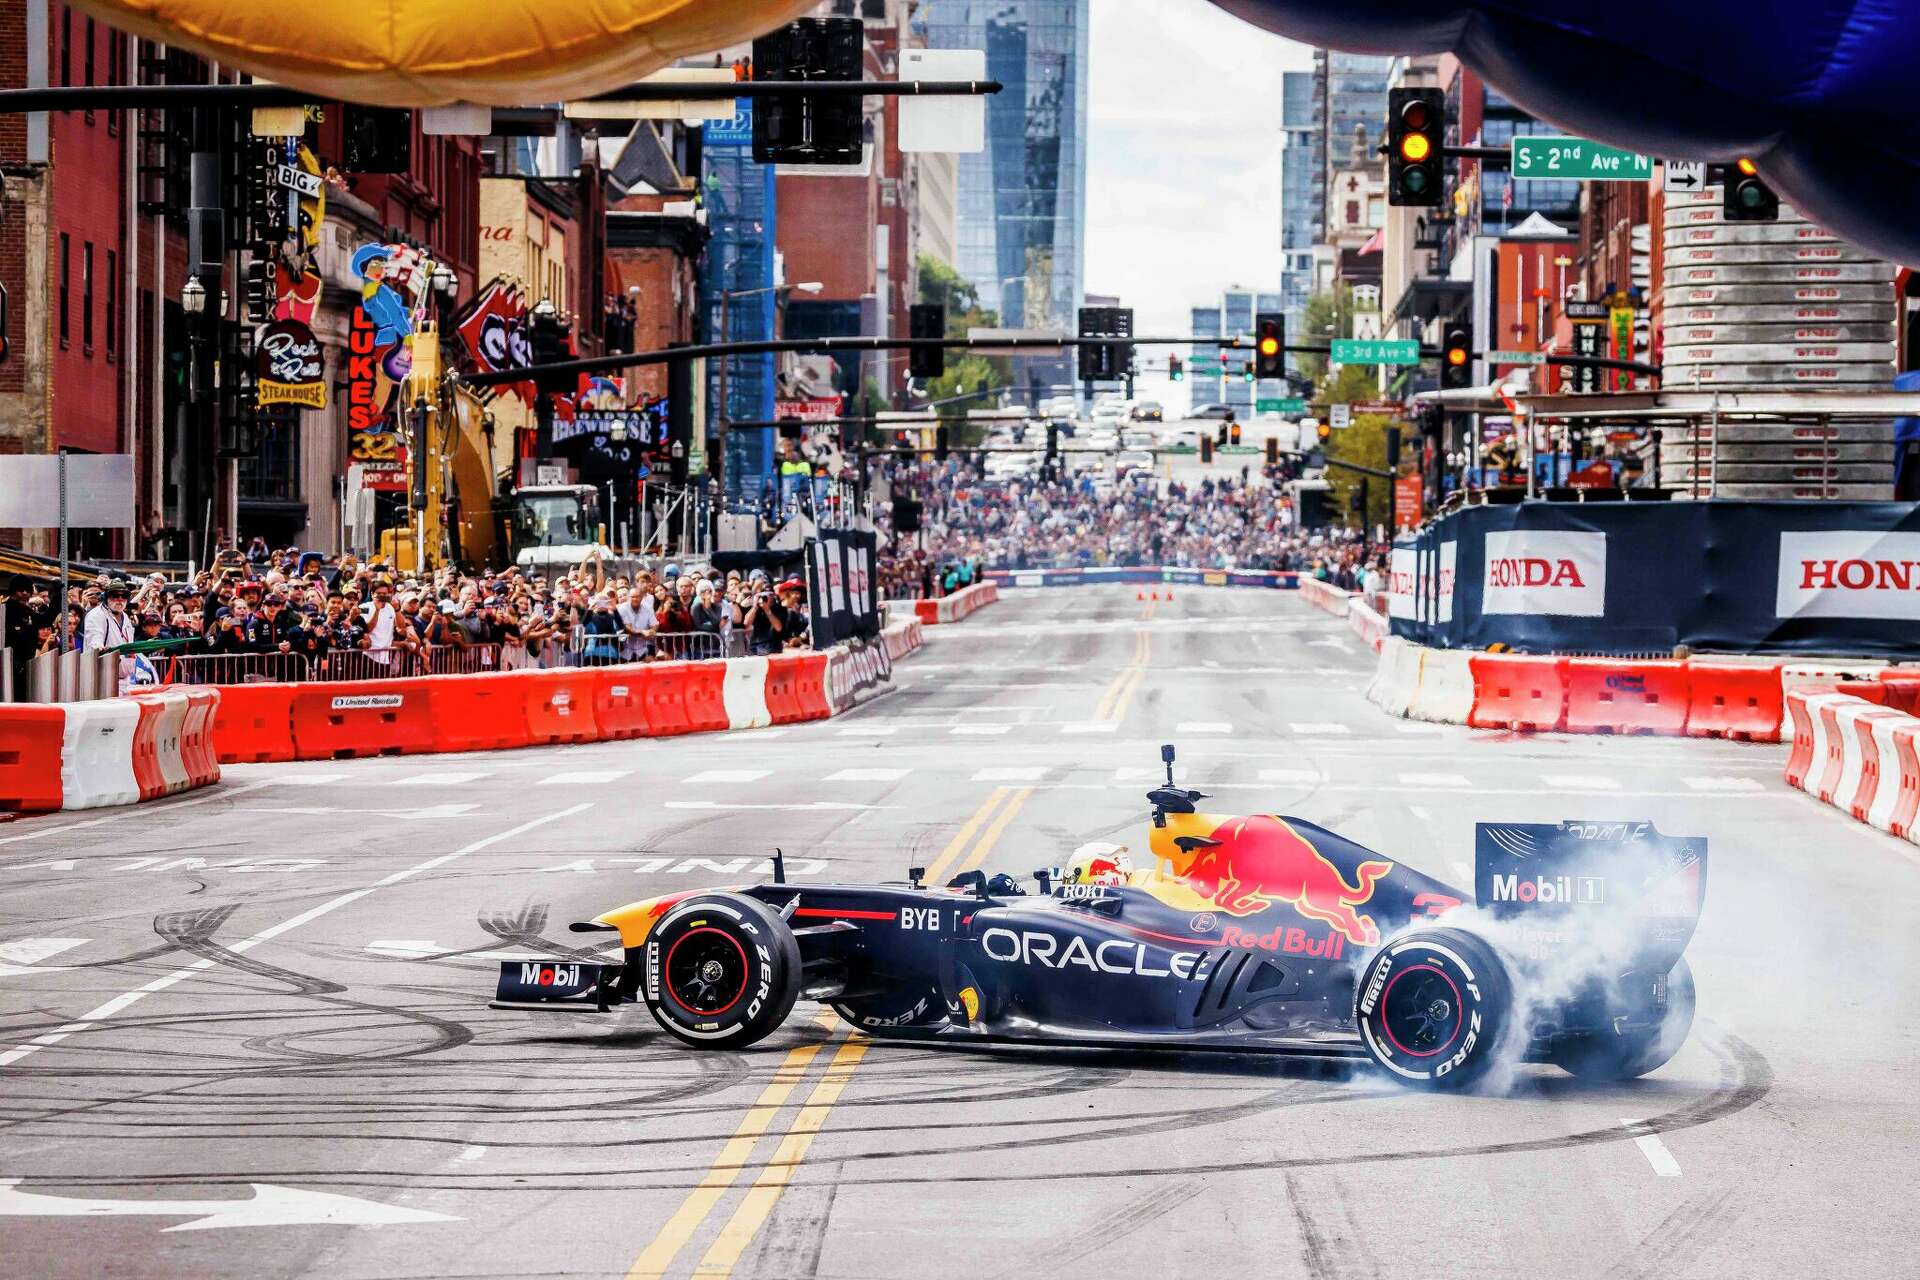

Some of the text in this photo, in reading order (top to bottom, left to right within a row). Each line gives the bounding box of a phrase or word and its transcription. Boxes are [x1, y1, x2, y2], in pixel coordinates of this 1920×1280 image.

[281, 167, 308, 191] BIG
[262, 383, 321, 403] STEAKHOUSE
[352, 431, 395, 460] 32
[1490, 558, 1586, 587] HONDA
[1492, 874, 1571, 902] Mobil
[982, 927, 1210, 982] ORACLE
[1219, 925, 1345, 961] Red Bull
[519, 962, 580, 987] Mobil
[646, 941, 660, 1001] PIRELLI
[747, 943, 772, 1020] ZERO
[1360, 955, 1393, 1016] PIRELLI
[1435, 1009, 1482, 1077] ZERO
